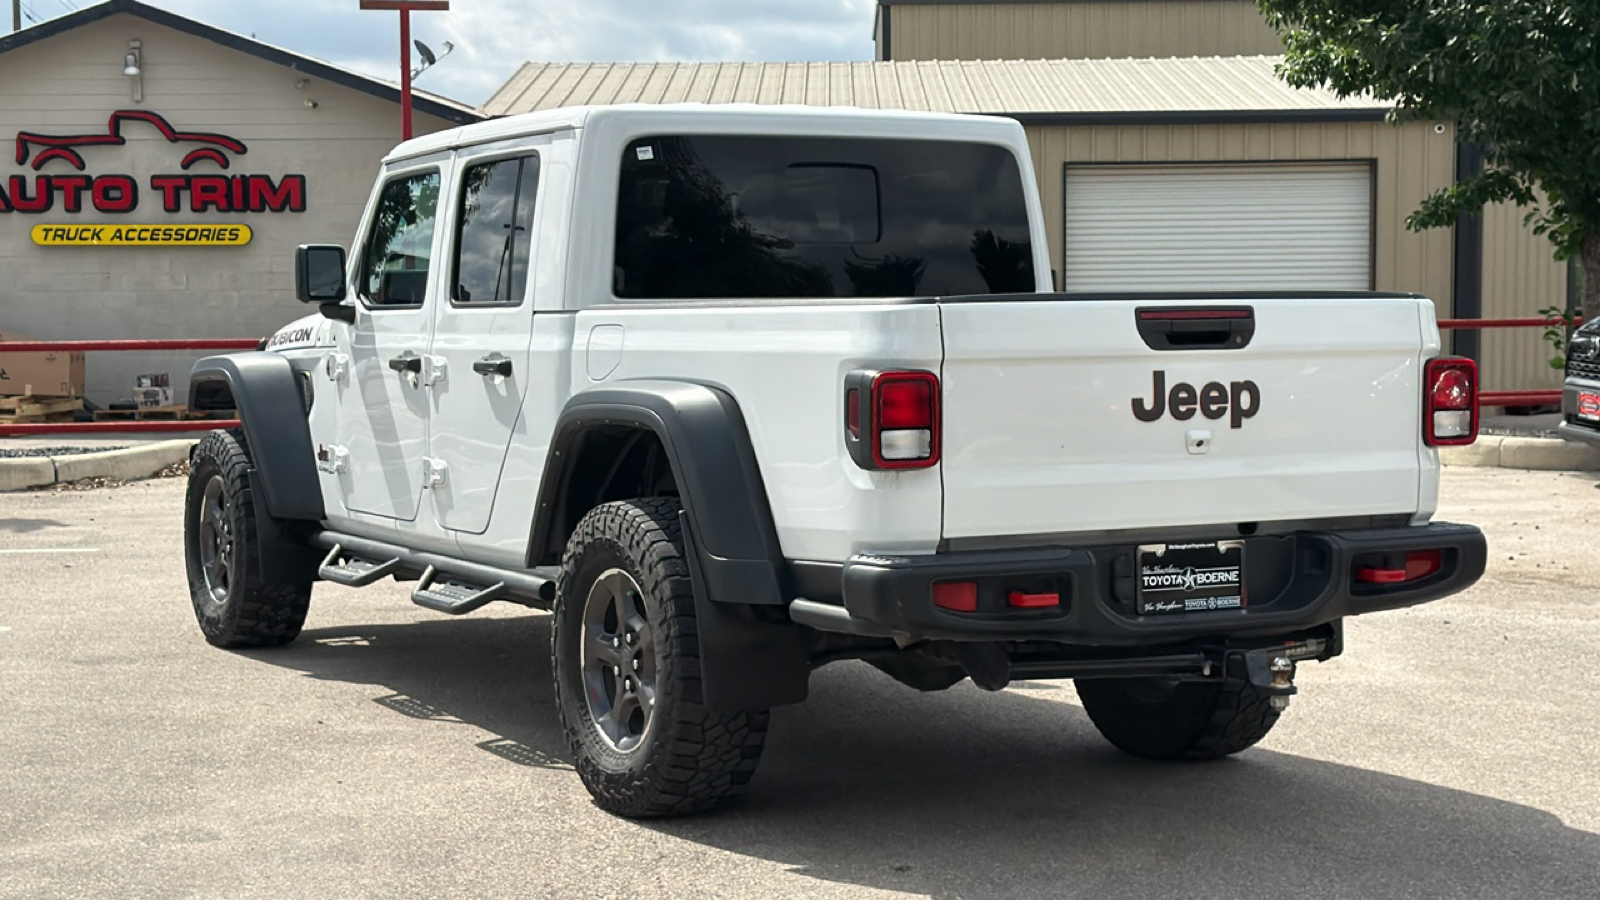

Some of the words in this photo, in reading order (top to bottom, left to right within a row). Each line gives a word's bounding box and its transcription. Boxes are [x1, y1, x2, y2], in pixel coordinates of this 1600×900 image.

[151, 174, 306, 212] TRIM
[42, 229, 103, 241] TRUCK
[110, 229, 240, 241] ACCESSORIES
[1131, 370, 1261, 429] Jeep
[1142, 575, 1182, 586] TOYOTA
[1197, 571, 1239, 584] BOERNE
